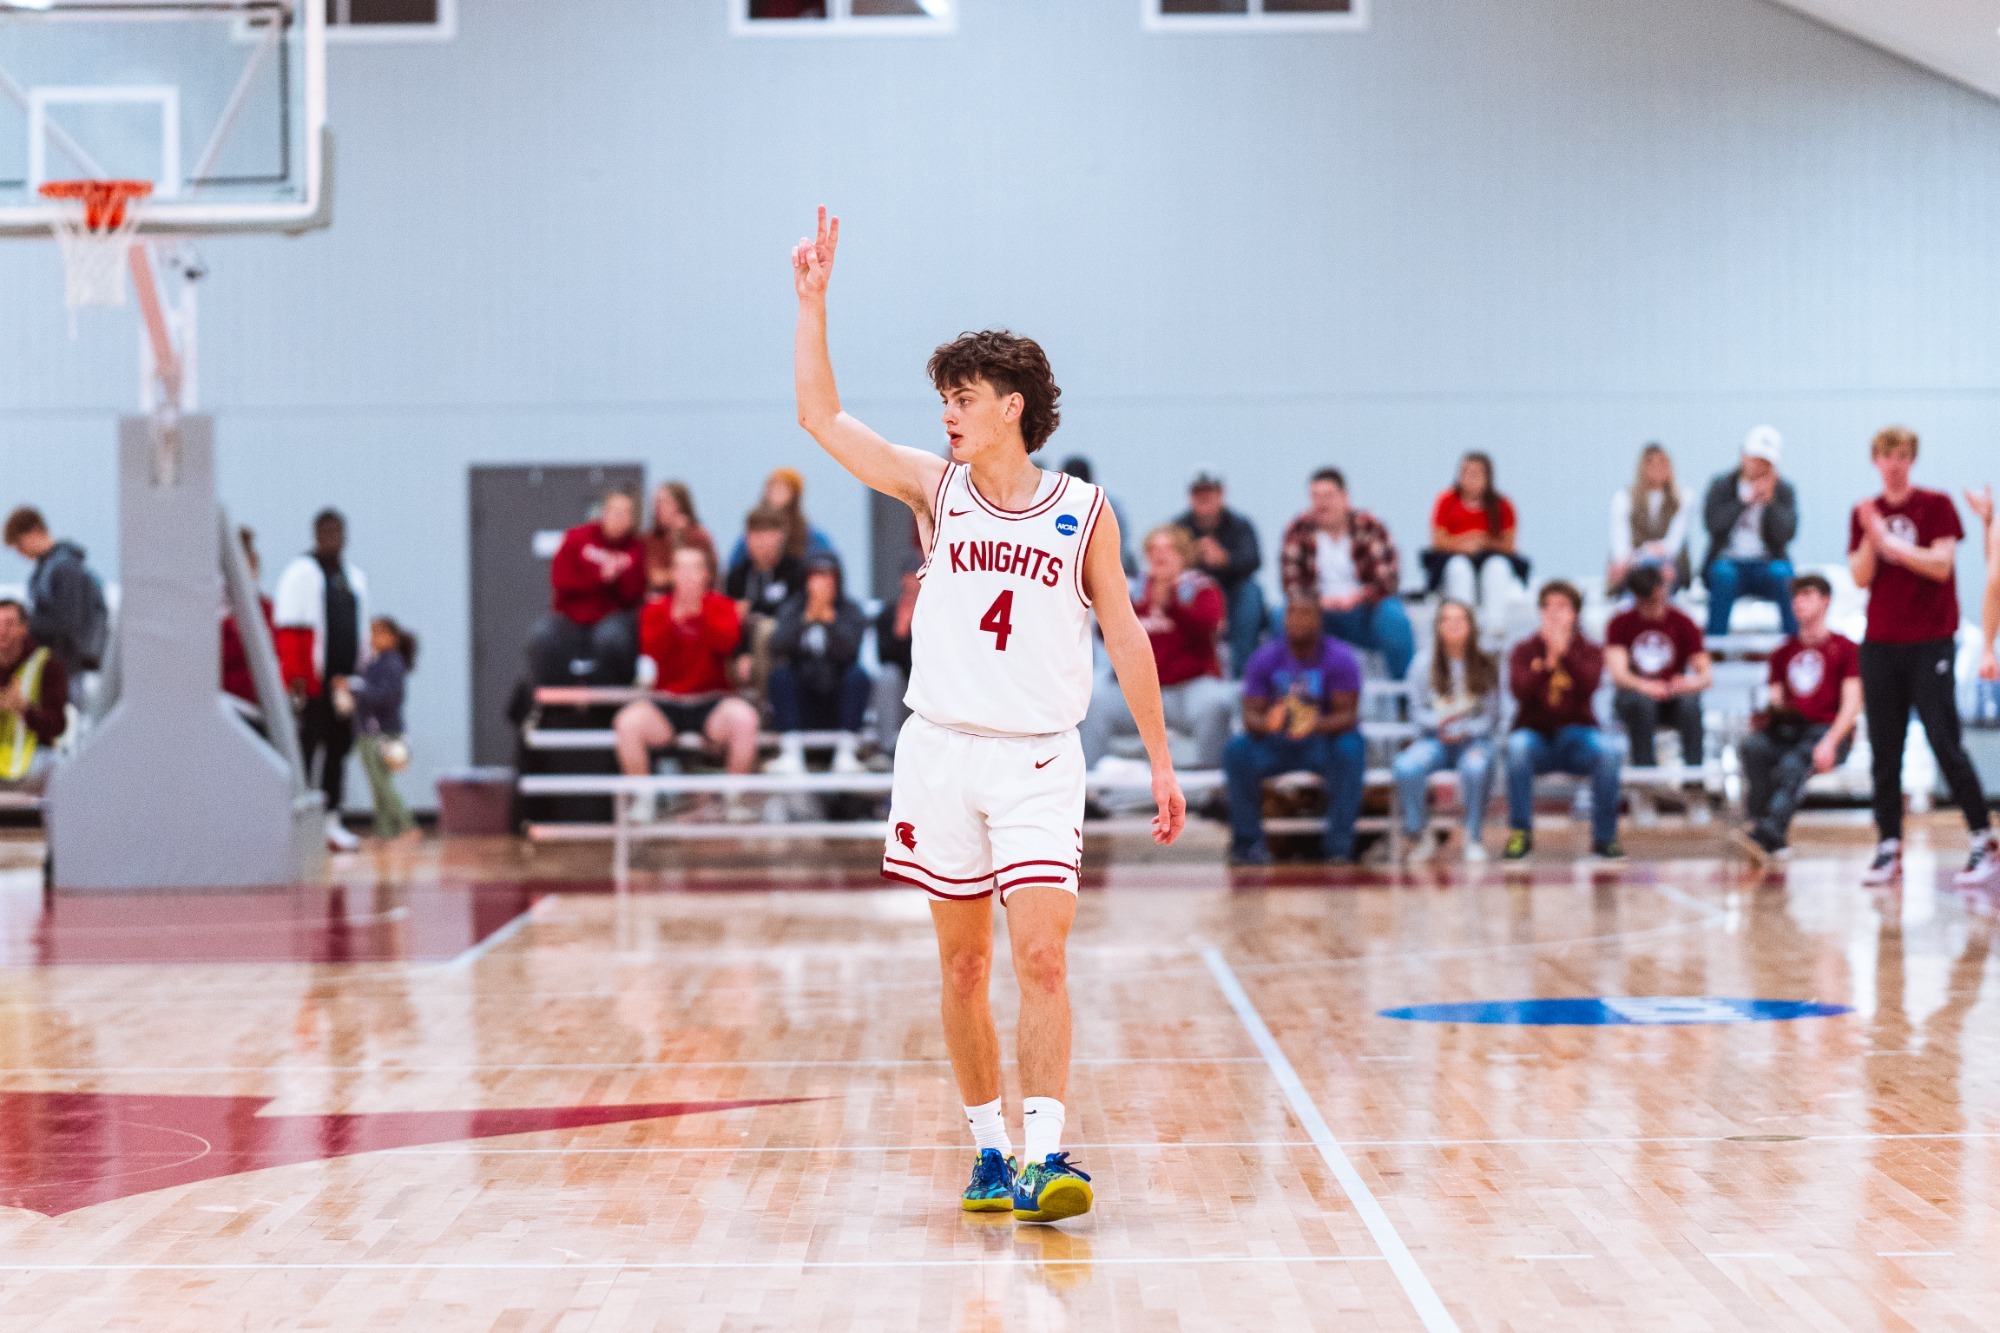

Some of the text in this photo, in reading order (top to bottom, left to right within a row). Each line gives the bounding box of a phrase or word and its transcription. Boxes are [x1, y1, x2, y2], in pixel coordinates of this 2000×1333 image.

[1056, 522, 1077, 533] NCAA
[949, 541, 1063, 587] KNIGHTS
[979, 589, 1013, 651] 4
